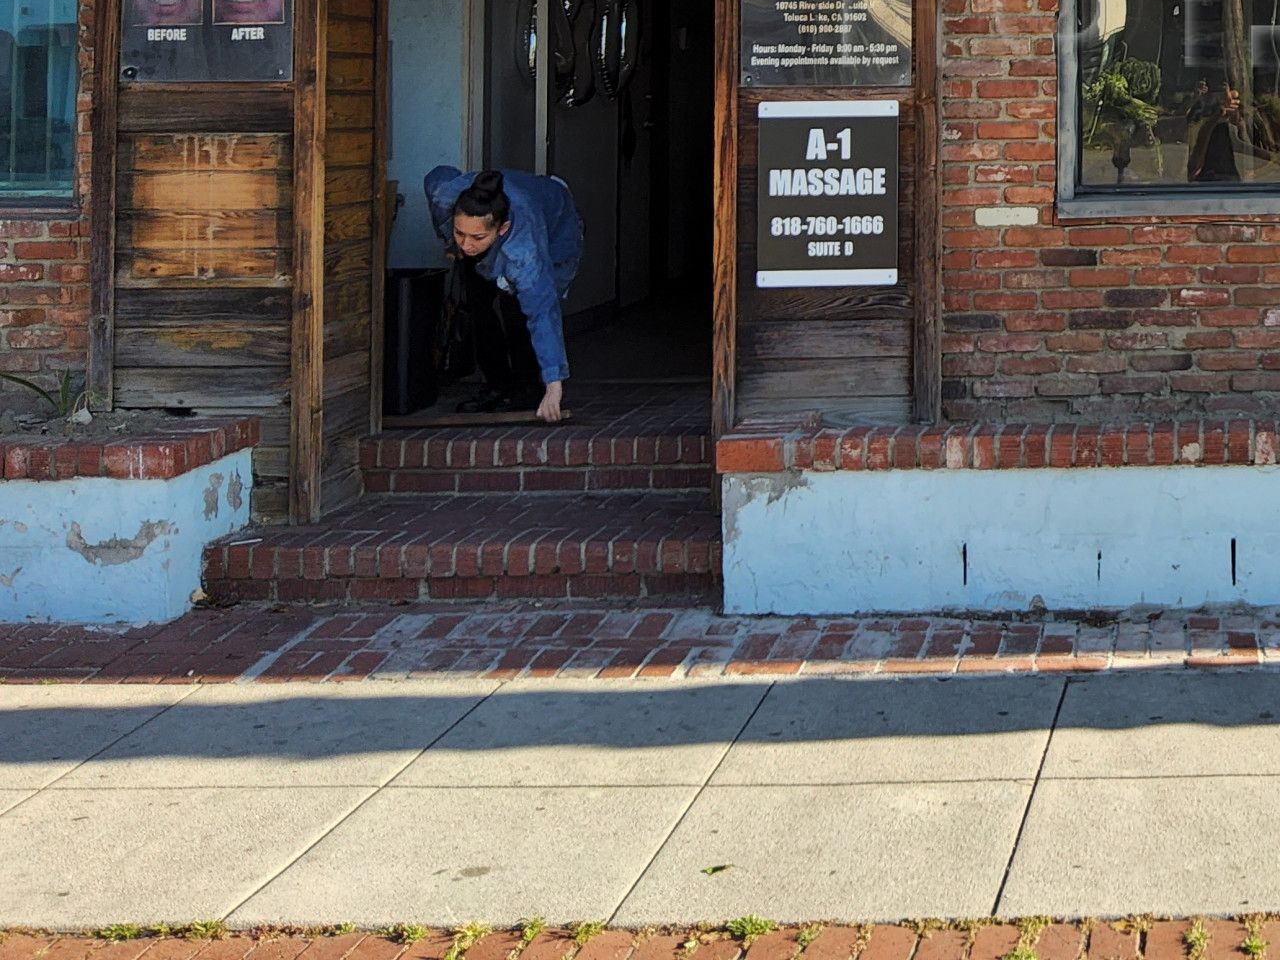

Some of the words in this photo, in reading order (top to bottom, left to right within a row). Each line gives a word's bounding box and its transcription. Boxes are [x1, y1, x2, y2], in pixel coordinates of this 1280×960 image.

[799, 1, 835, 10] Riveside
[810, 12, 830, 22] Lke,
[147, 28, 187, 41] BEFORE
[231, 27, 264, 40] AFTER
[778, 44, 806, 56] Monday
[805, 127, 852, 161] A-1
[769, 167, 887, 197] MASSAGE
[770, 215, 884, 237] 818-760-1666
[808, 241, 841, 257] SUITE
